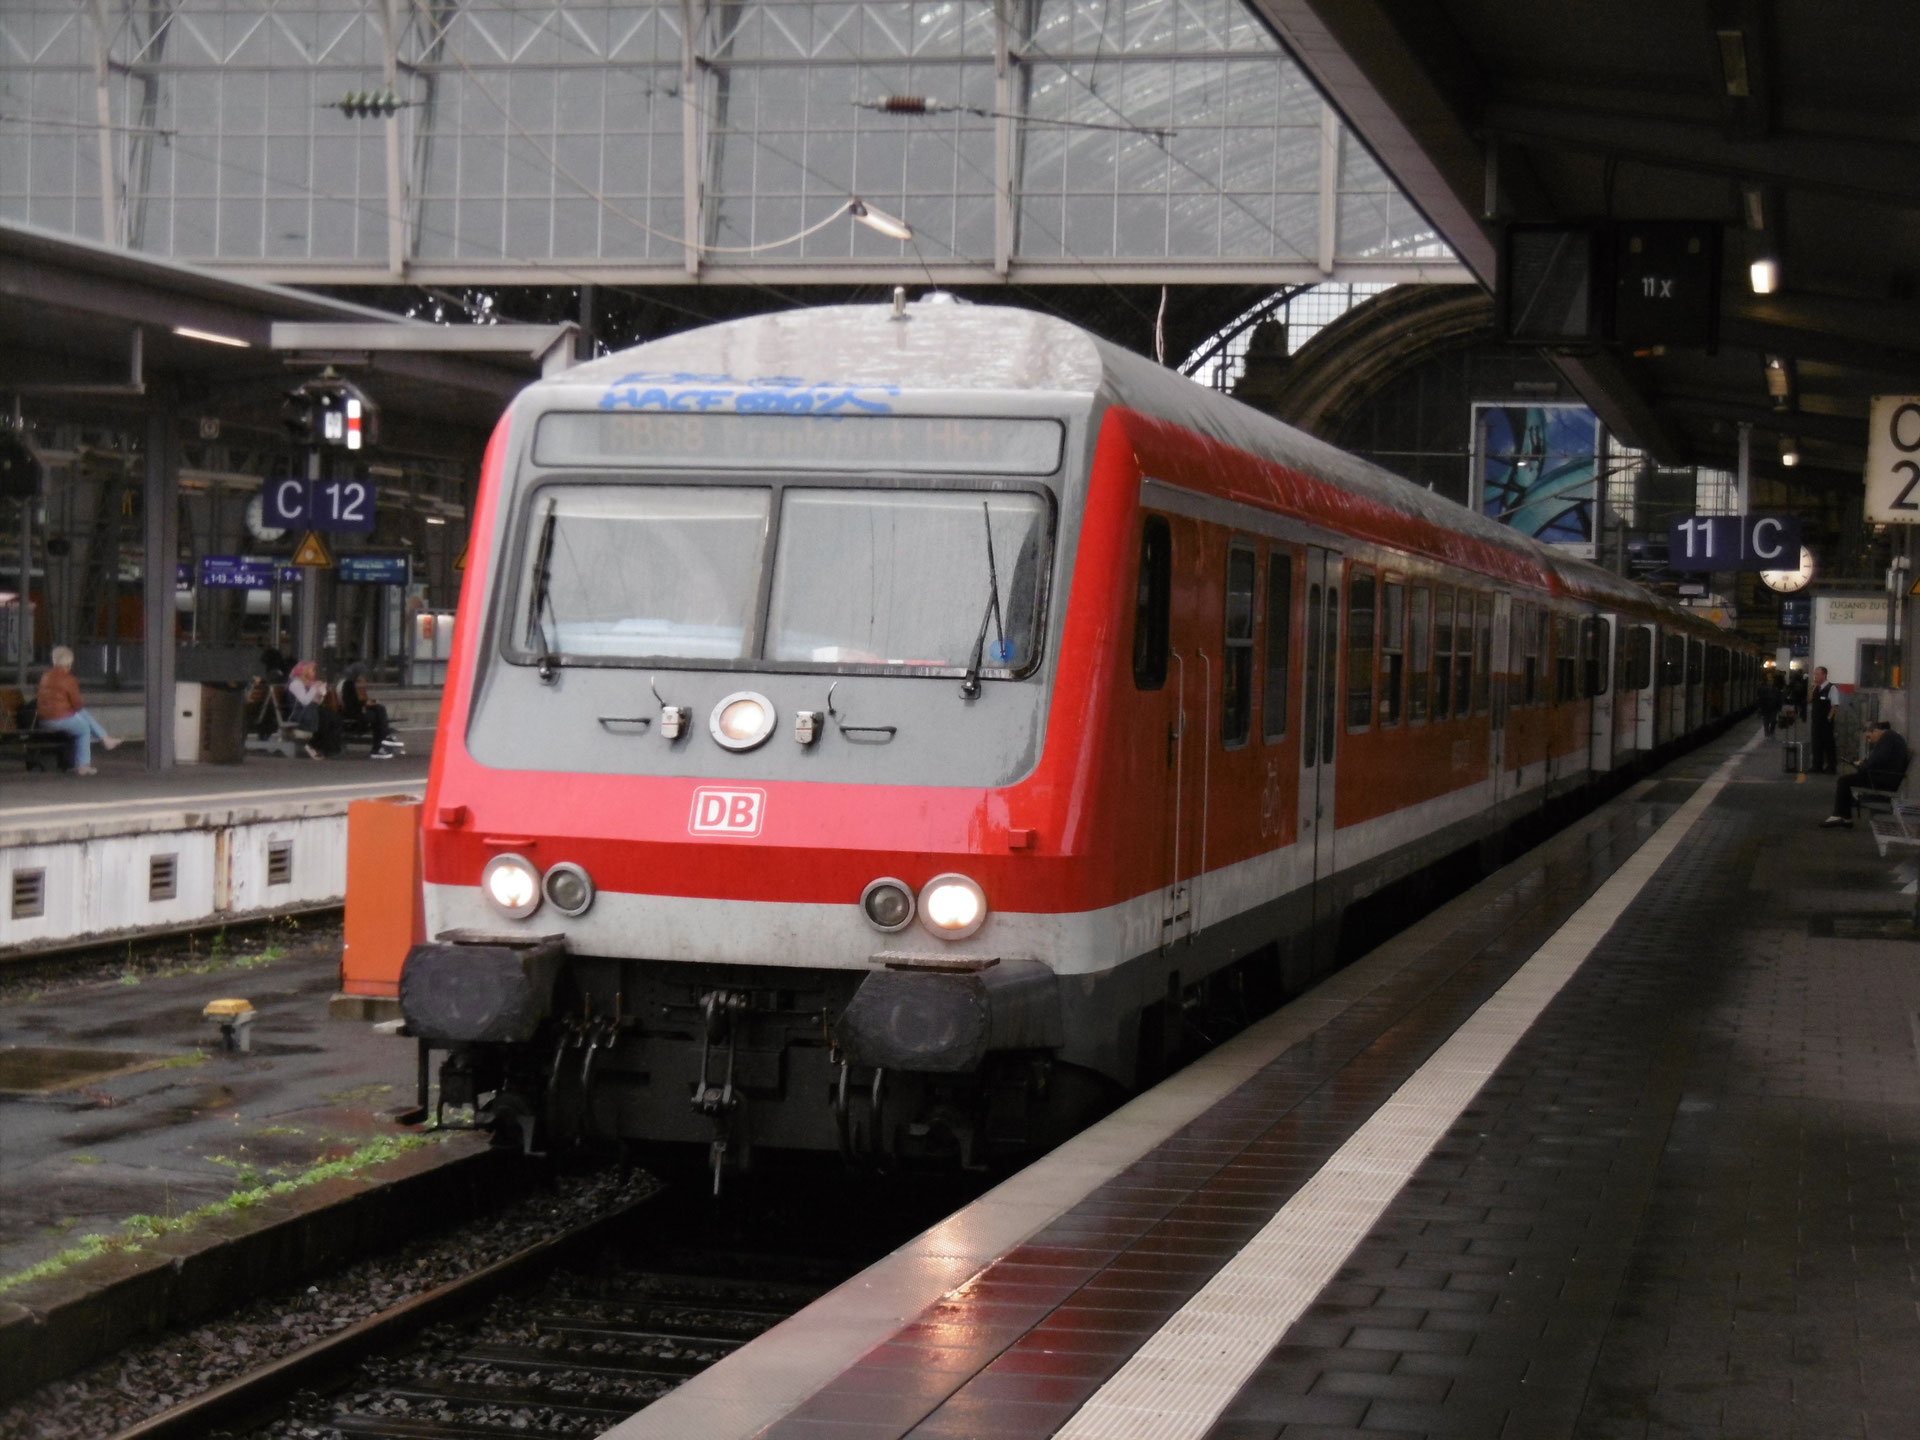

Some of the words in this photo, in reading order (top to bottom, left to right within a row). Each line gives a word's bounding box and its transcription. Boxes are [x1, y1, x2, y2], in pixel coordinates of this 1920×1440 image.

[1641, 277, 1654, 297] 11
[276, 480, 304, 519] C
[325, 482, 366, 522] 12
[1889, 459, 1920, 510] 2
[1676, 518, 1713, 558] 11
[1751, 517, 1783, 559] C
[1784, 601, 1793, 611] 11
[699, 794, 755, 828] DB
